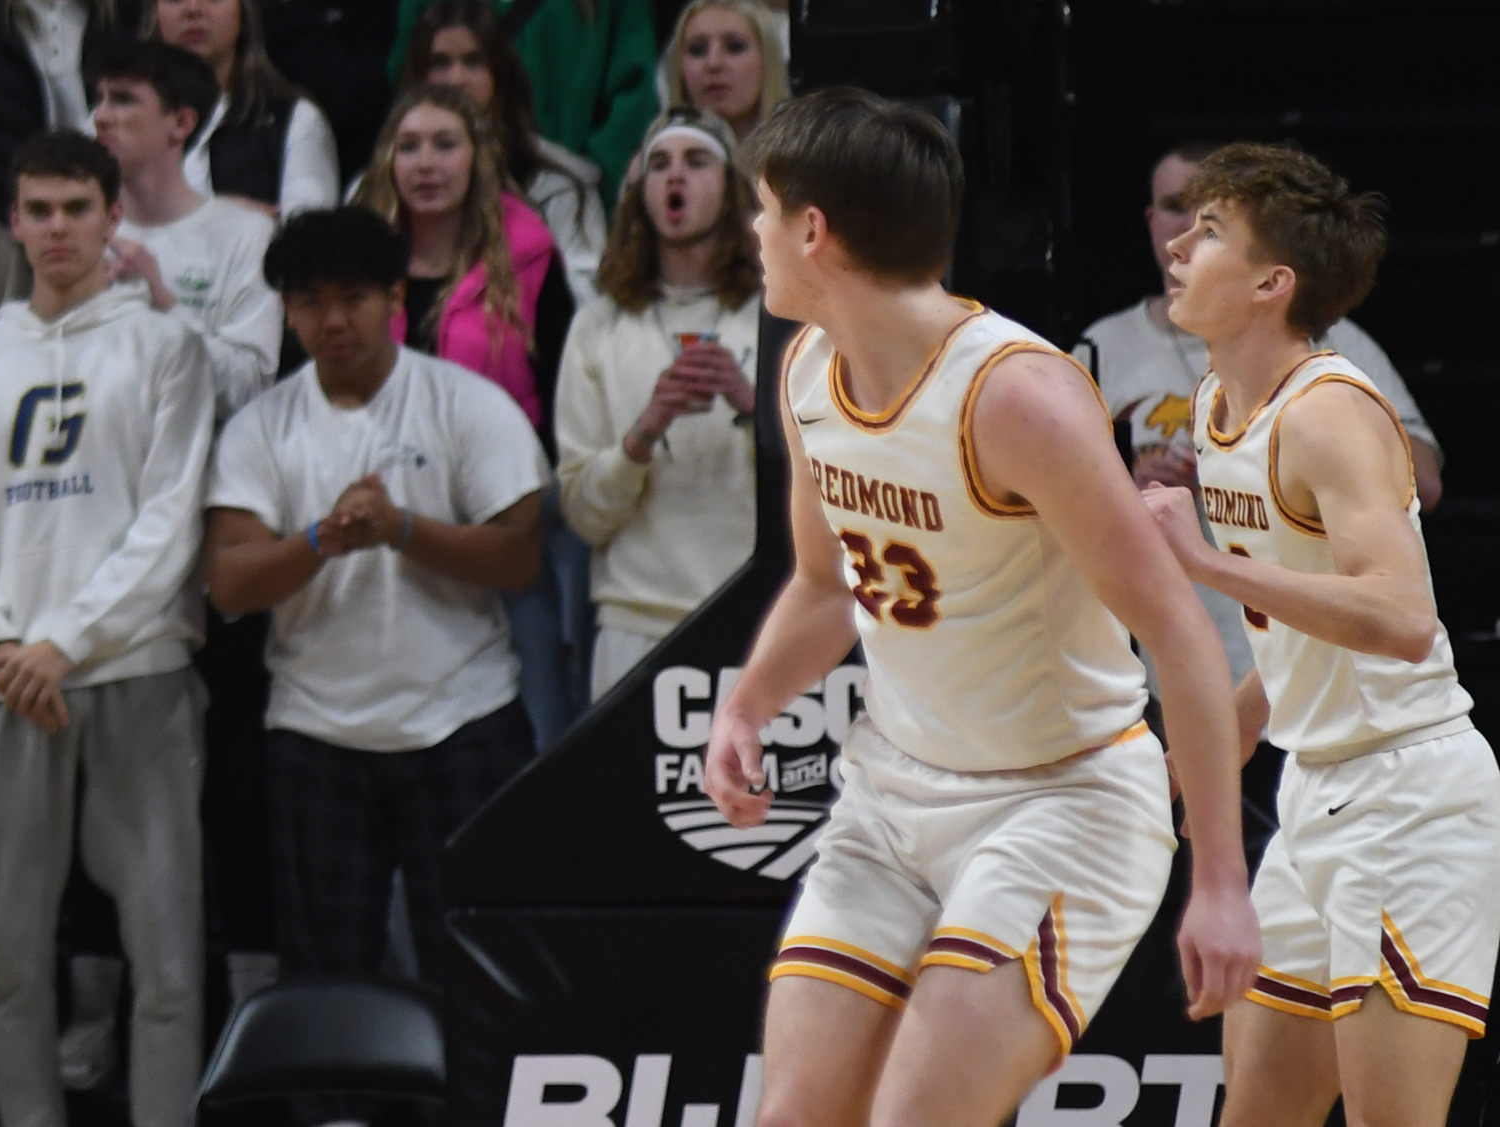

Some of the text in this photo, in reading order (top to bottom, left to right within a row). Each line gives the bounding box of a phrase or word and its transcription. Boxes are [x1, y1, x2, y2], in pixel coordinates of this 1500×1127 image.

[6, 473, 95, 506] FOOTBALL
[1200, 485, 1270, 531] EDMOND
[781, 756, 827, 785] and
